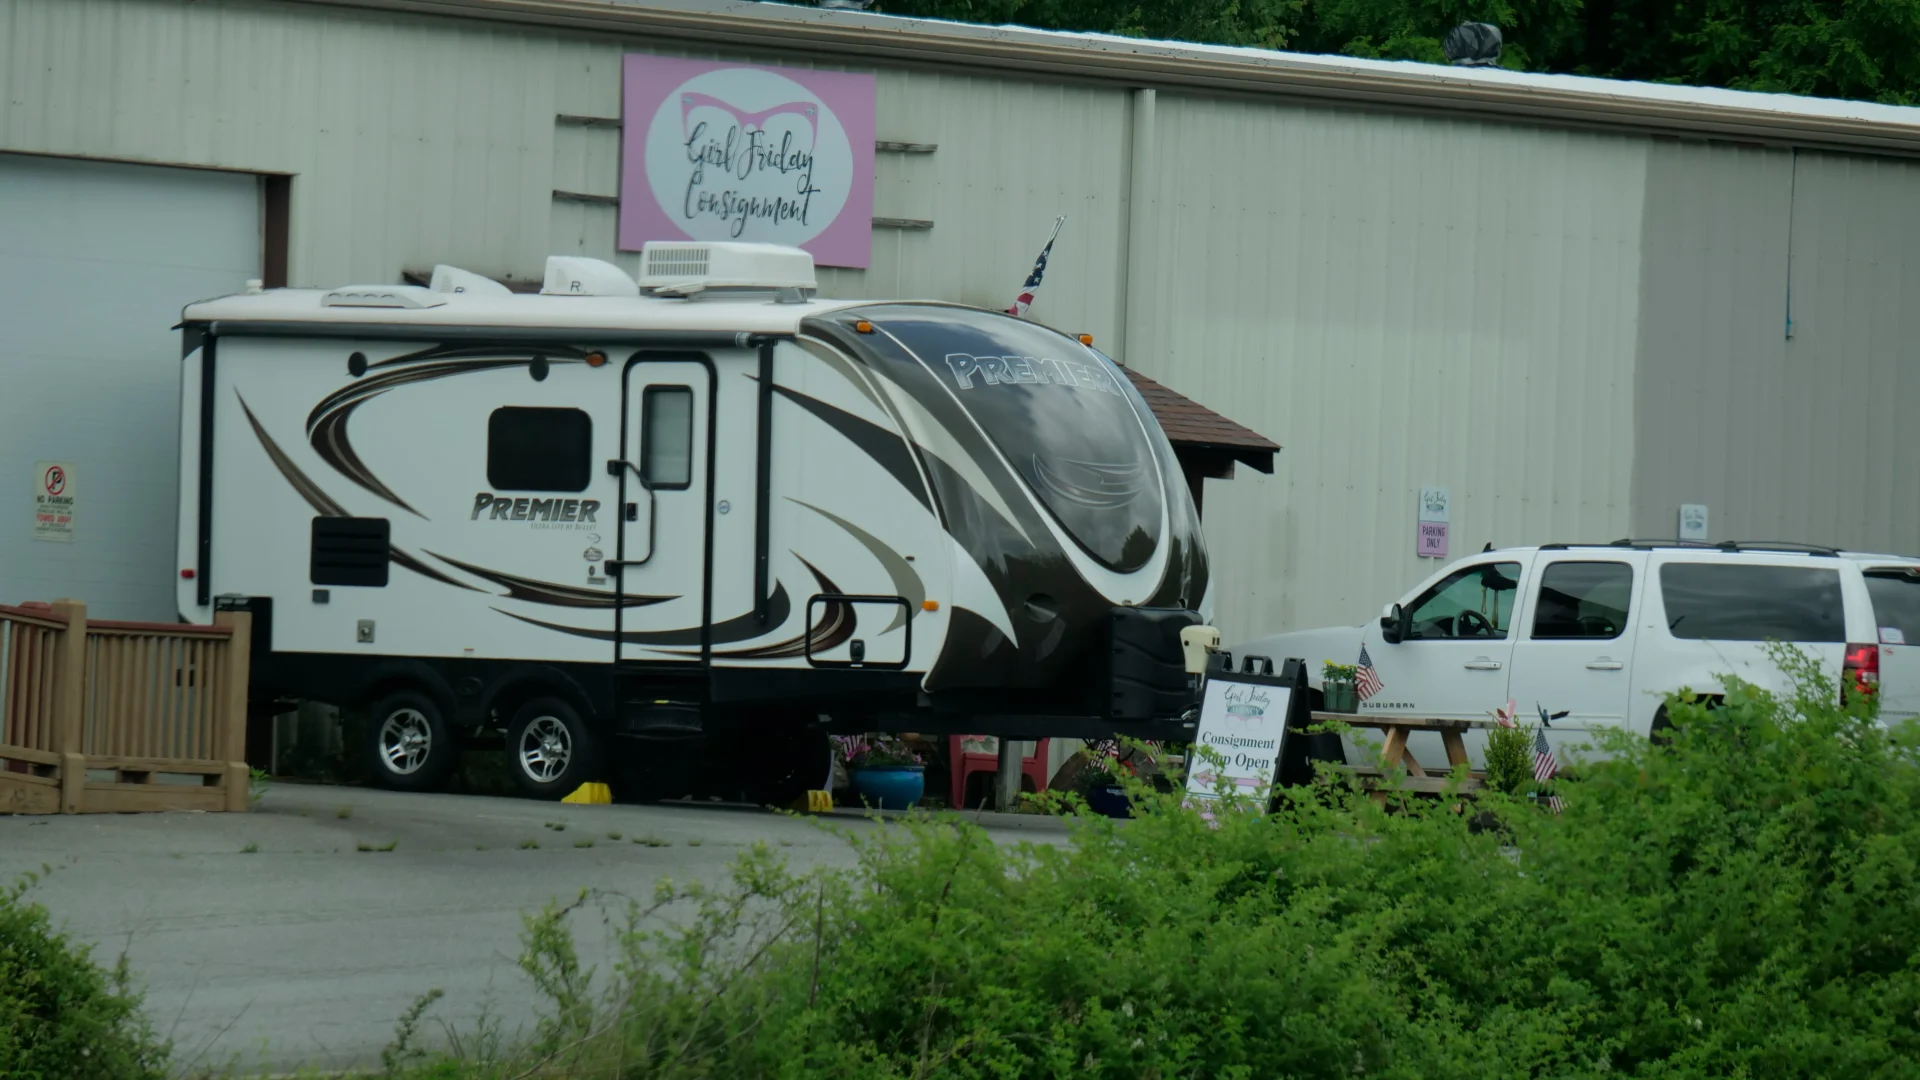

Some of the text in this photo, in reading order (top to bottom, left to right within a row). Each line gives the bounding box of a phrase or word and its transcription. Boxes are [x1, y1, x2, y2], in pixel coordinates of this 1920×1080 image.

[684, 121, 814, 195] Girl Friday
[684, 170, 821, 238] Consignment
[945, 353, 1121, 397] PREMIER
[37, 495, 73, 504] NO PARKING
[470, 492, 601, 523] PREMIER
[1422, 526, 1446, 537] PARKING
[1426, 538, 1441, 548] ONLY
[1202, 731, 1275, 749] Consignment
[1235, 753, 1270, 771] Open
